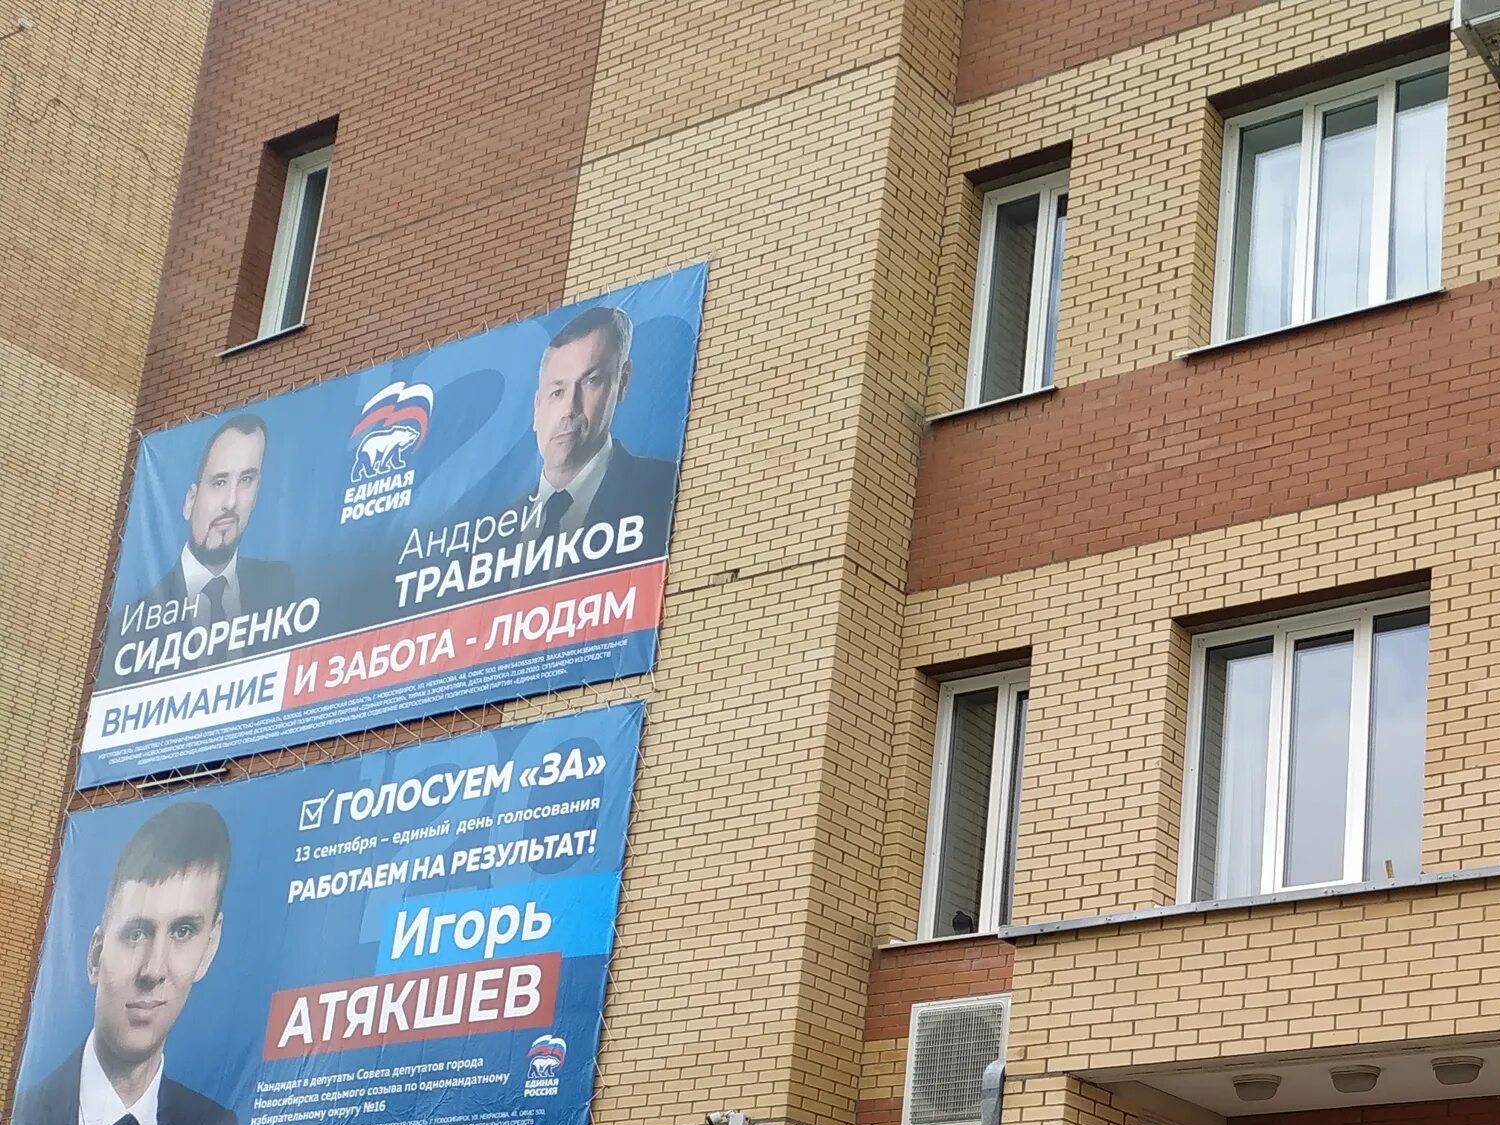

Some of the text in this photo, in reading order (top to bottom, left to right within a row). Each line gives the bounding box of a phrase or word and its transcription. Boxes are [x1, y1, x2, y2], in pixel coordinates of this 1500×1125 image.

[340, 493, 412, 524] РОССИЯ
[343, 469, 415, 505] ЕДИНАЯ
[398, 493, 544, 565] Андрей
[394, 515, 645, 608] ТРАВНИКОВ
[114, 597, 320, 676] СИДОРЕНКО
[120, 594, 200, 636] Иван
[101, 671, 278, 738] ВНИМАНИЕ
[293, 661, 318, 696] И
[324, 629, 455, 688] ЗАБОТА
[484, 586, 637, 651] ЛЮДЯМ
[332, 748, 607, 824] ГОЛОСУЕМ «ЗА»
[294, 846, 310, 863] 13
[313, 836, 377, 860] сентября
[392, 820, 450, 846] единый
[456, 815, 493, 835] день
[496, 797, 600, 826] голосования
[288, 829, 598, 903] РАБОТАЕМ НА РЕЗУЛЬТАТ!
[391, 901, 552, 960] Игорь
[277, 964, 542, 1048] АТЯКШЕВ
[254, 1073, 510, 1110] Новосибирска седьмого созыва по одномандатному
[256, 1057, 484, 1093] Кандидат в депутаты Совета депутатов города
[524, 1087, 558, 1098] РОССИЯ
[525, 1078, 559, 1089] ЕДИНАЯ
[250, 1100, 386, 1125] избирательному округу №16
